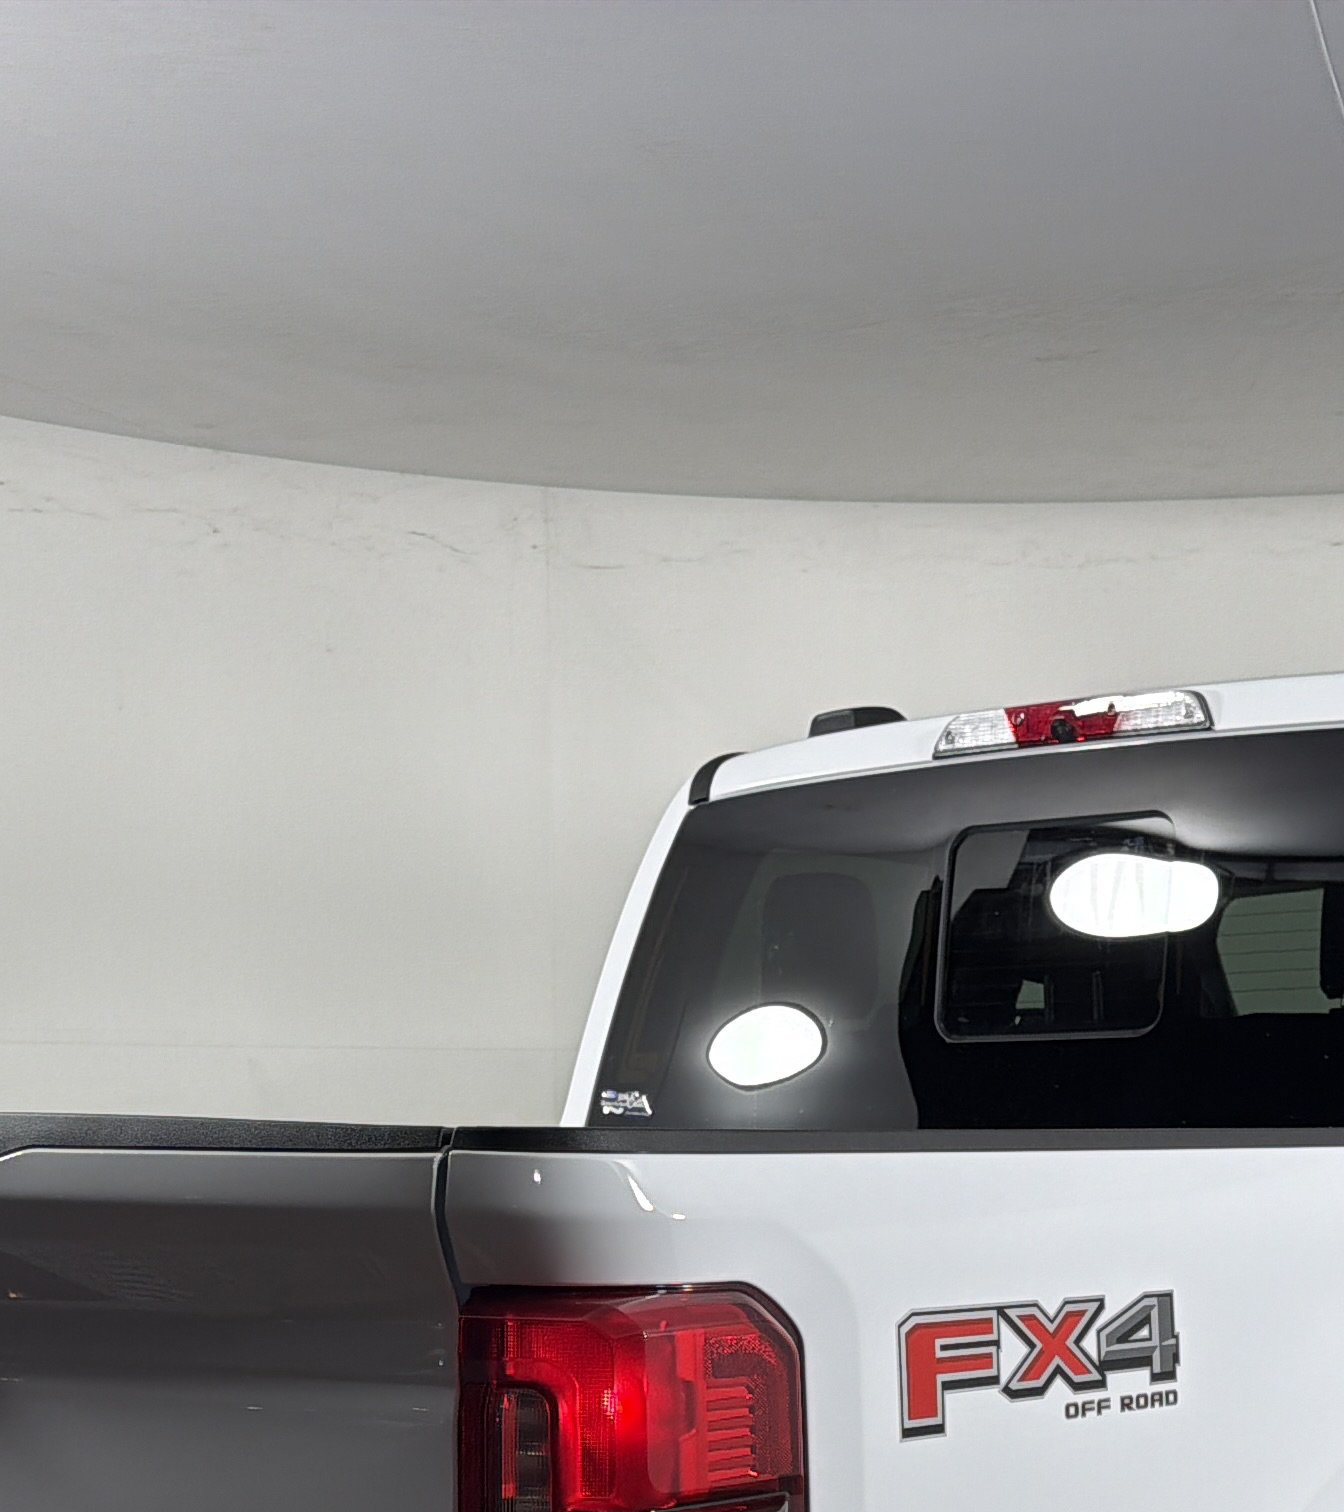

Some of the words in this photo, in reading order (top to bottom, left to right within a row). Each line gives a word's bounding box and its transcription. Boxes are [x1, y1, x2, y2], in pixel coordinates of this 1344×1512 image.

[896, 1289, 1180, 1442] FX4
[1064, 1398, 1111, 1420] OFF
[1119, 1388, 1178, 1413] ROAD
